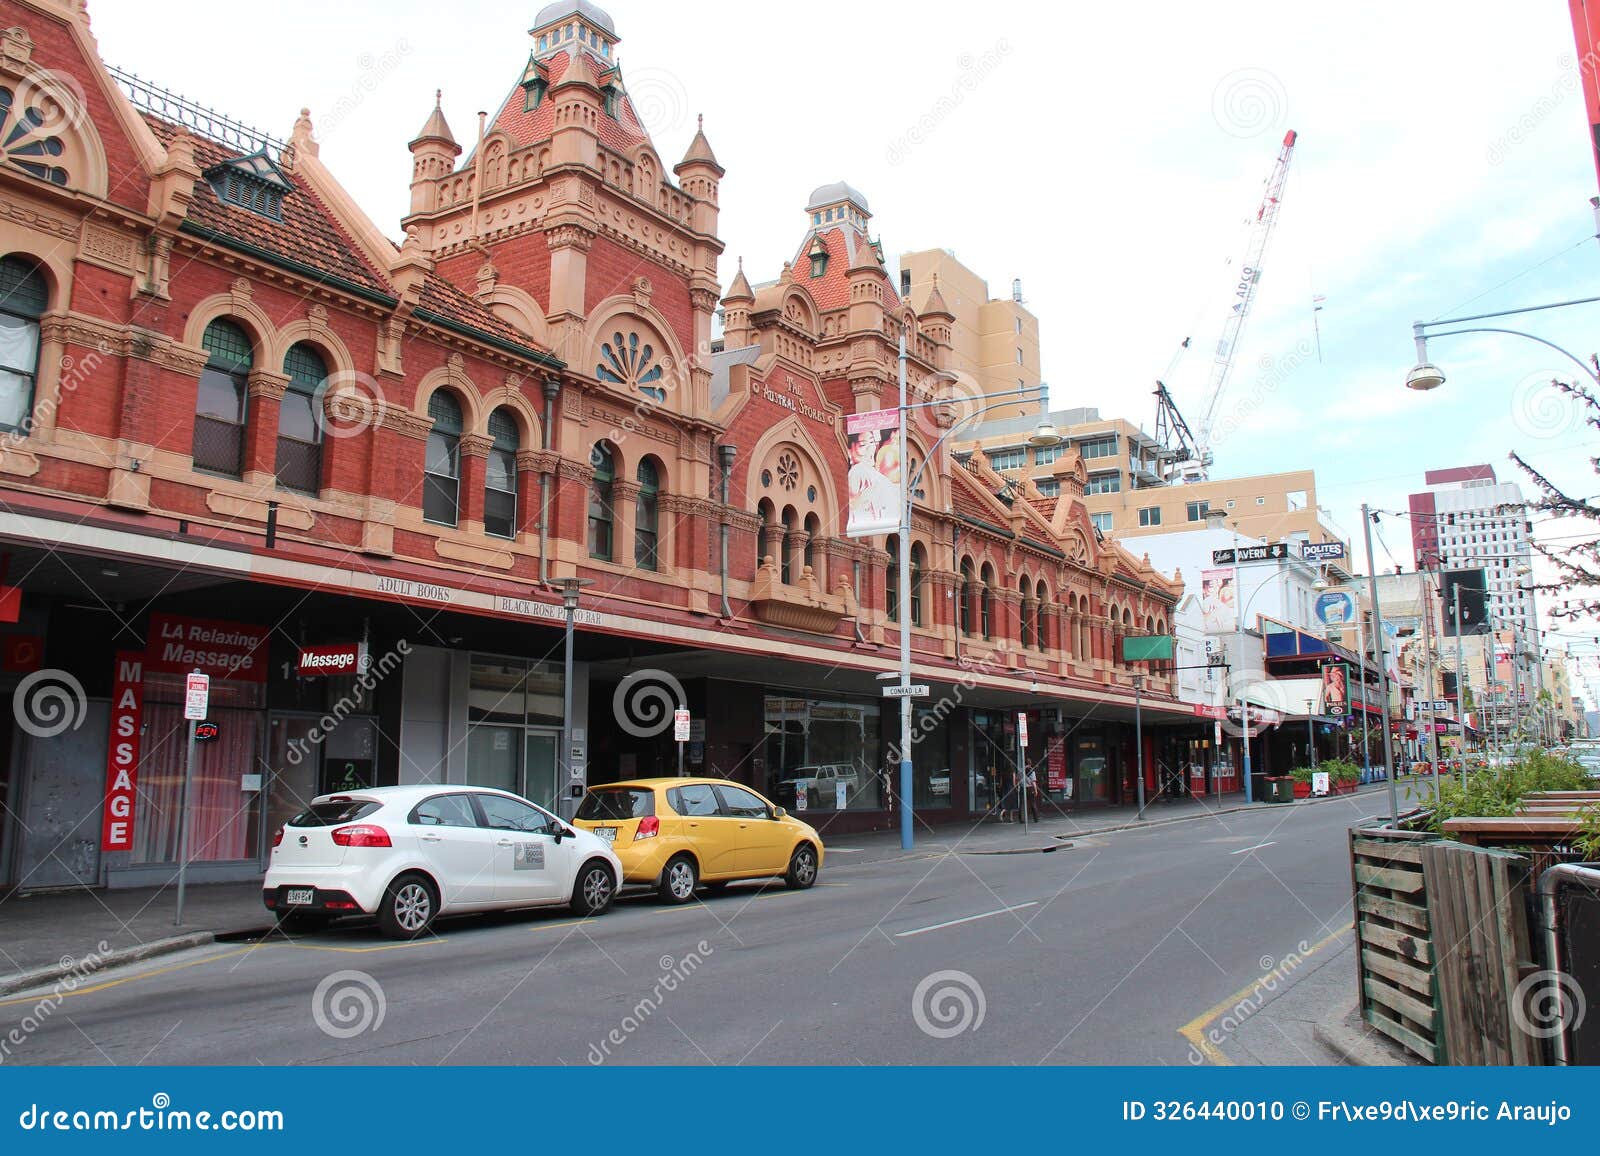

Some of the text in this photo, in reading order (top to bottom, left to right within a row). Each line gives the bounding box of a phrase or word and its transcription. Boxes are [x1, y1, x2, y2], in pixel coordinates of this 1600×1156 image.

[1238, 548, 1267, 559] AVERN
[1304, 543, 1341, 555] POLITES
[378, 577, 450, 600] ADULT BOOKS
[502, 598, 601, 625] BLACK ROSE PINO BAR
[161, 623, 259, 649] LA Relaxing
[162, 643, 254, 671] Massage
[301, 652, 355, 669] Massage
[195, 727, 218, 736] PEN
[110, 661, 141, 844] MASSAGE
